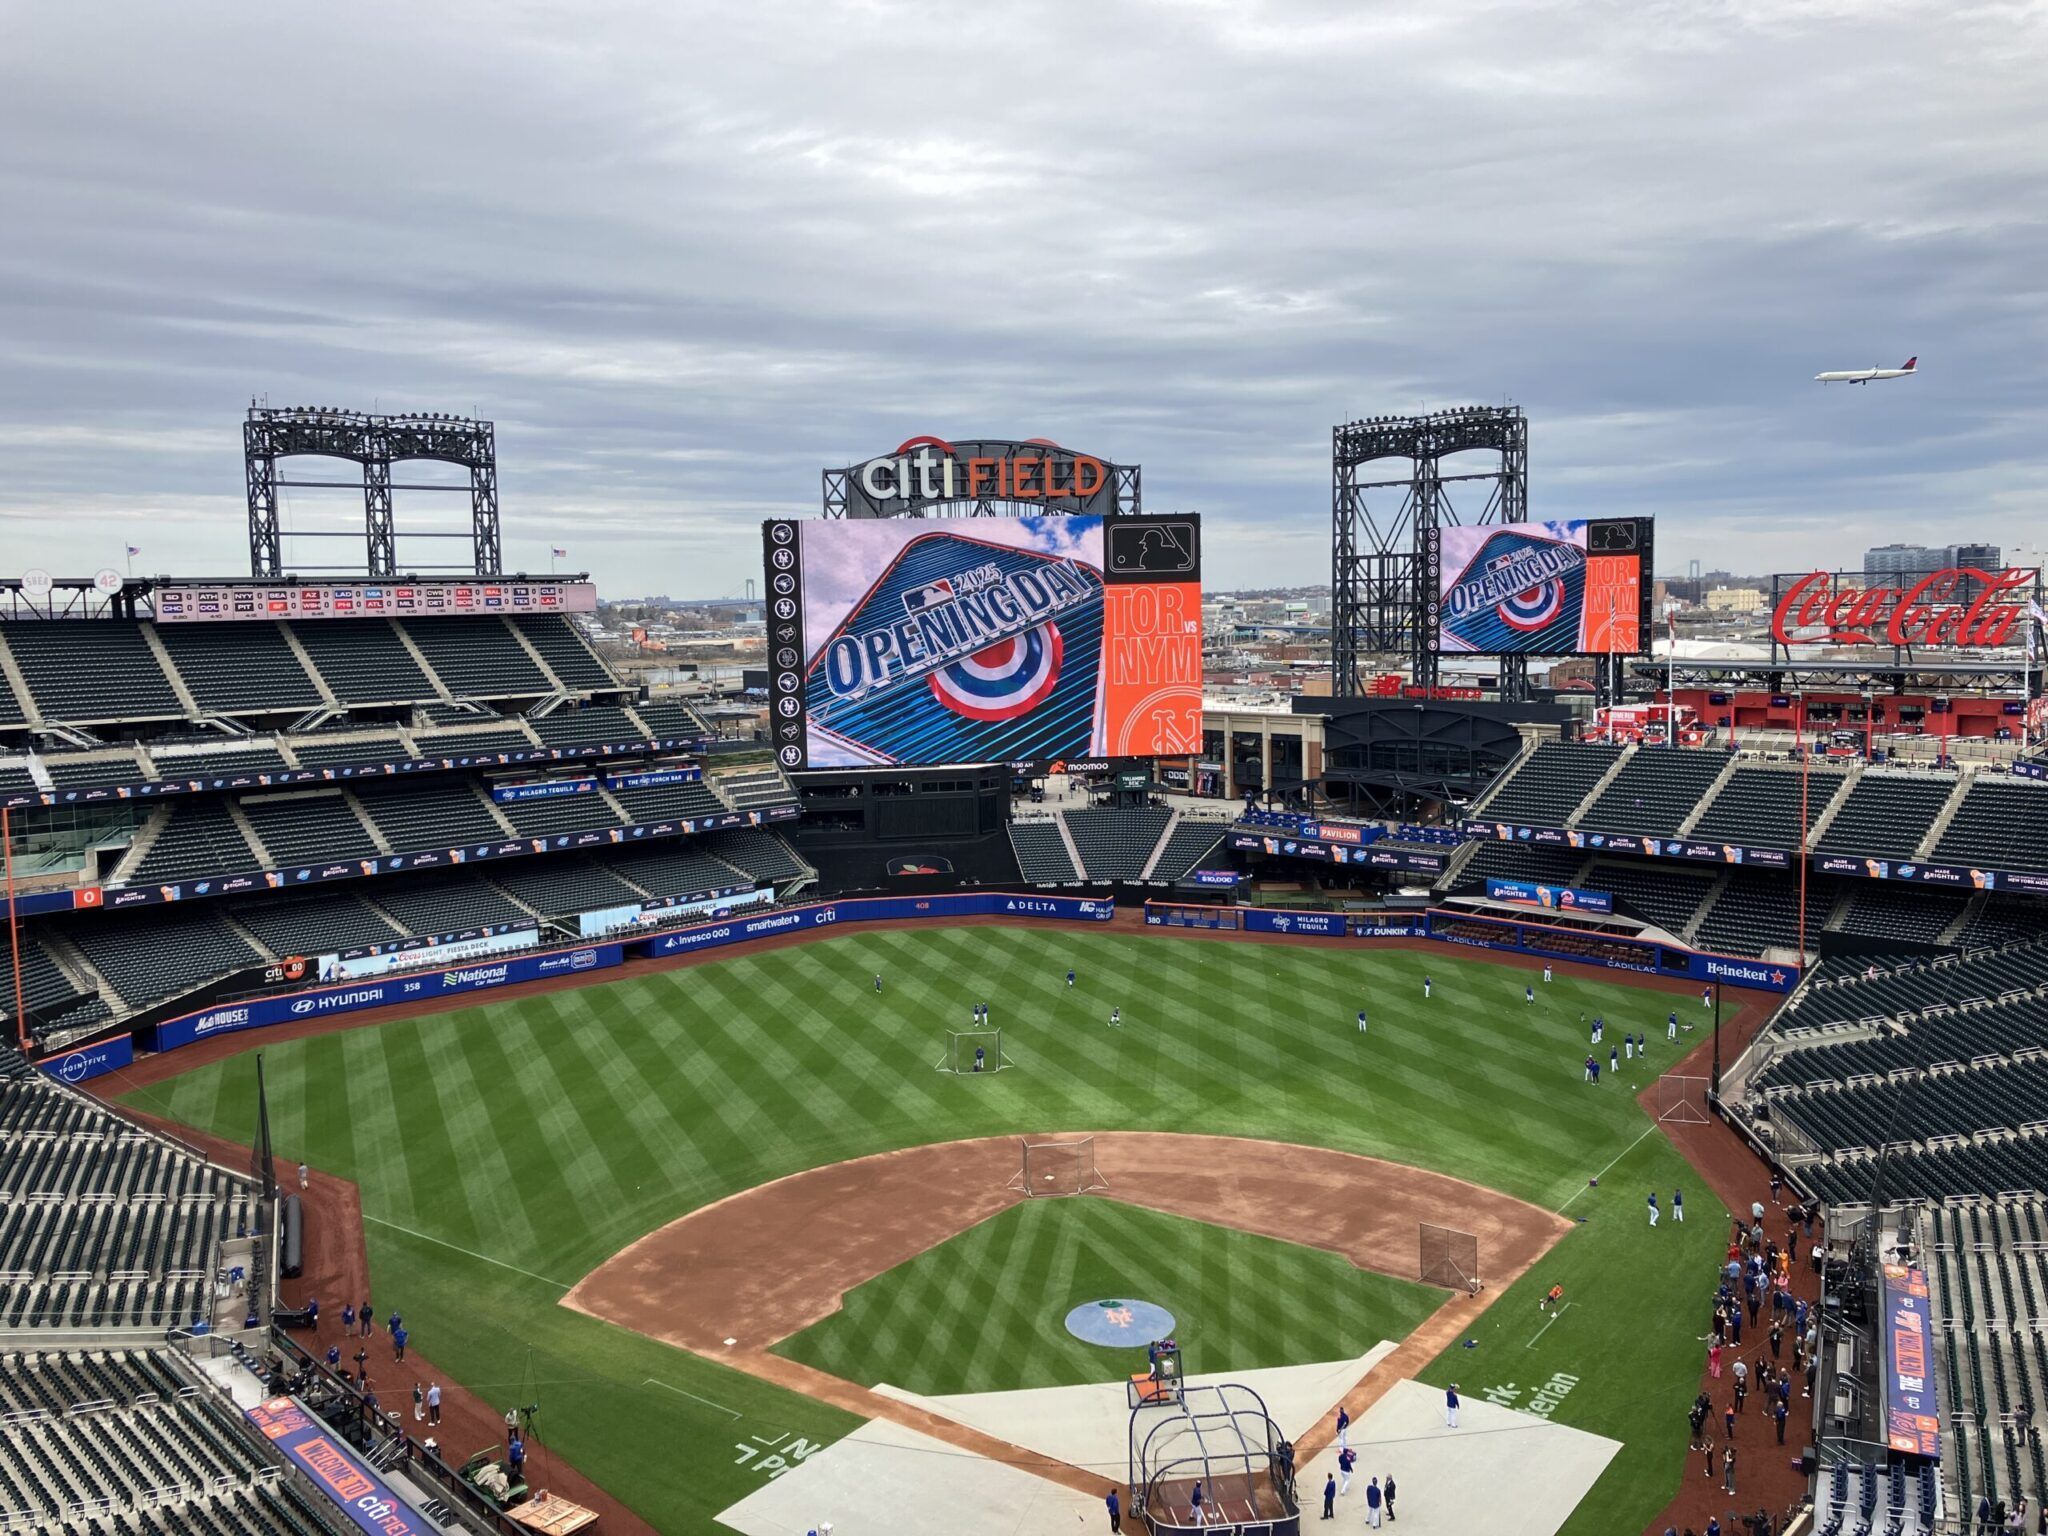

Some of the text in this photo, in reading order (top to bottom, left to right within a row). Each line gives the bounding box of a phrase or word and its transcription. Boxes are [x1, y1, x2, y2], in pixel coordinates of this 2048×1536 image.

[862, 447, 1104, 499] citi FIELD
[954, 562, 1002, 593] 2025
[1589, 557, 1630, 586] TOR
[26, 577, 49, 586] SHEA
[100, 575, 117, 588] 42
[1450, 543, 1581, 617] OPENING DAY
[1589, 586, 1637, 613] NYM
[1106, 586, 1184, 635] TOR
[826, 557, 1093, 697] OPENING DAY
[1113, 635, 1198, 685] NYM
[1068, 762, 1109, 771] moomoo
[519, 788, 547, 796] MILAGRO
[548, 786, 574, 794] TEQUILA
[1304, 826, 1358, 840] citi PAVILION
[1301, 847, 1326, 855] BRIGHTER
[1609, 840, 1636, 848] BRIGHTER
[1372, 855, 1398, 864] BRIGHTER
[1687, 848, 1716, 857] BRIGHTER
[1823, 861, 1857, 870] BRIGHTER
[1201, 875, 1233, 884] $10,000
[1923, 871, 1960, 881] BRIGHTER
[1494, 888, 1528, 898] BRIGHTER
[915, 902, 930, 910] 408
[1018, 901, 1057, 912] DELTA
[815, 908, 836, 924] citi
[1297, 916, 1329, 924] MILAGRO
[747, 915, 793, 932] smartwater
[1298, 923, 1328, 931] TEQUILA
[679, 927, 730, 945] Invesco QQQ
[1374, 927, 1426, 936] DUNKIN' 370
[447, 943, 469, 953] FIESTA
[471, 941, 489, 950] DECK
[1446, 936, 1490, 948] CADILLAC
[265, 961, 303, 978] citi 00
[1607, 961, 1657, 973] CADILLAC
[1707, 962, 1767, 980] Heineken
[458, 965, 508, 984] National
[486, 976, 506, 985] Rental
[403, 982, 421, 992] 358
[318, 988, 383, 1009] HYUNDAI
[214, 1009, 244, 1025] HOUSE
[59, 1054, 107, 1075] 1POINTFIVE
[1897, 1331, 1921, 1352] YORK
[1899, 1353, 1922, 1374] NEW
[1899, 1375, 1924, 1393] THE
[302, 1442, 368, 1495] WELCOME TO
[357, 1496, 390, 1520] citi
